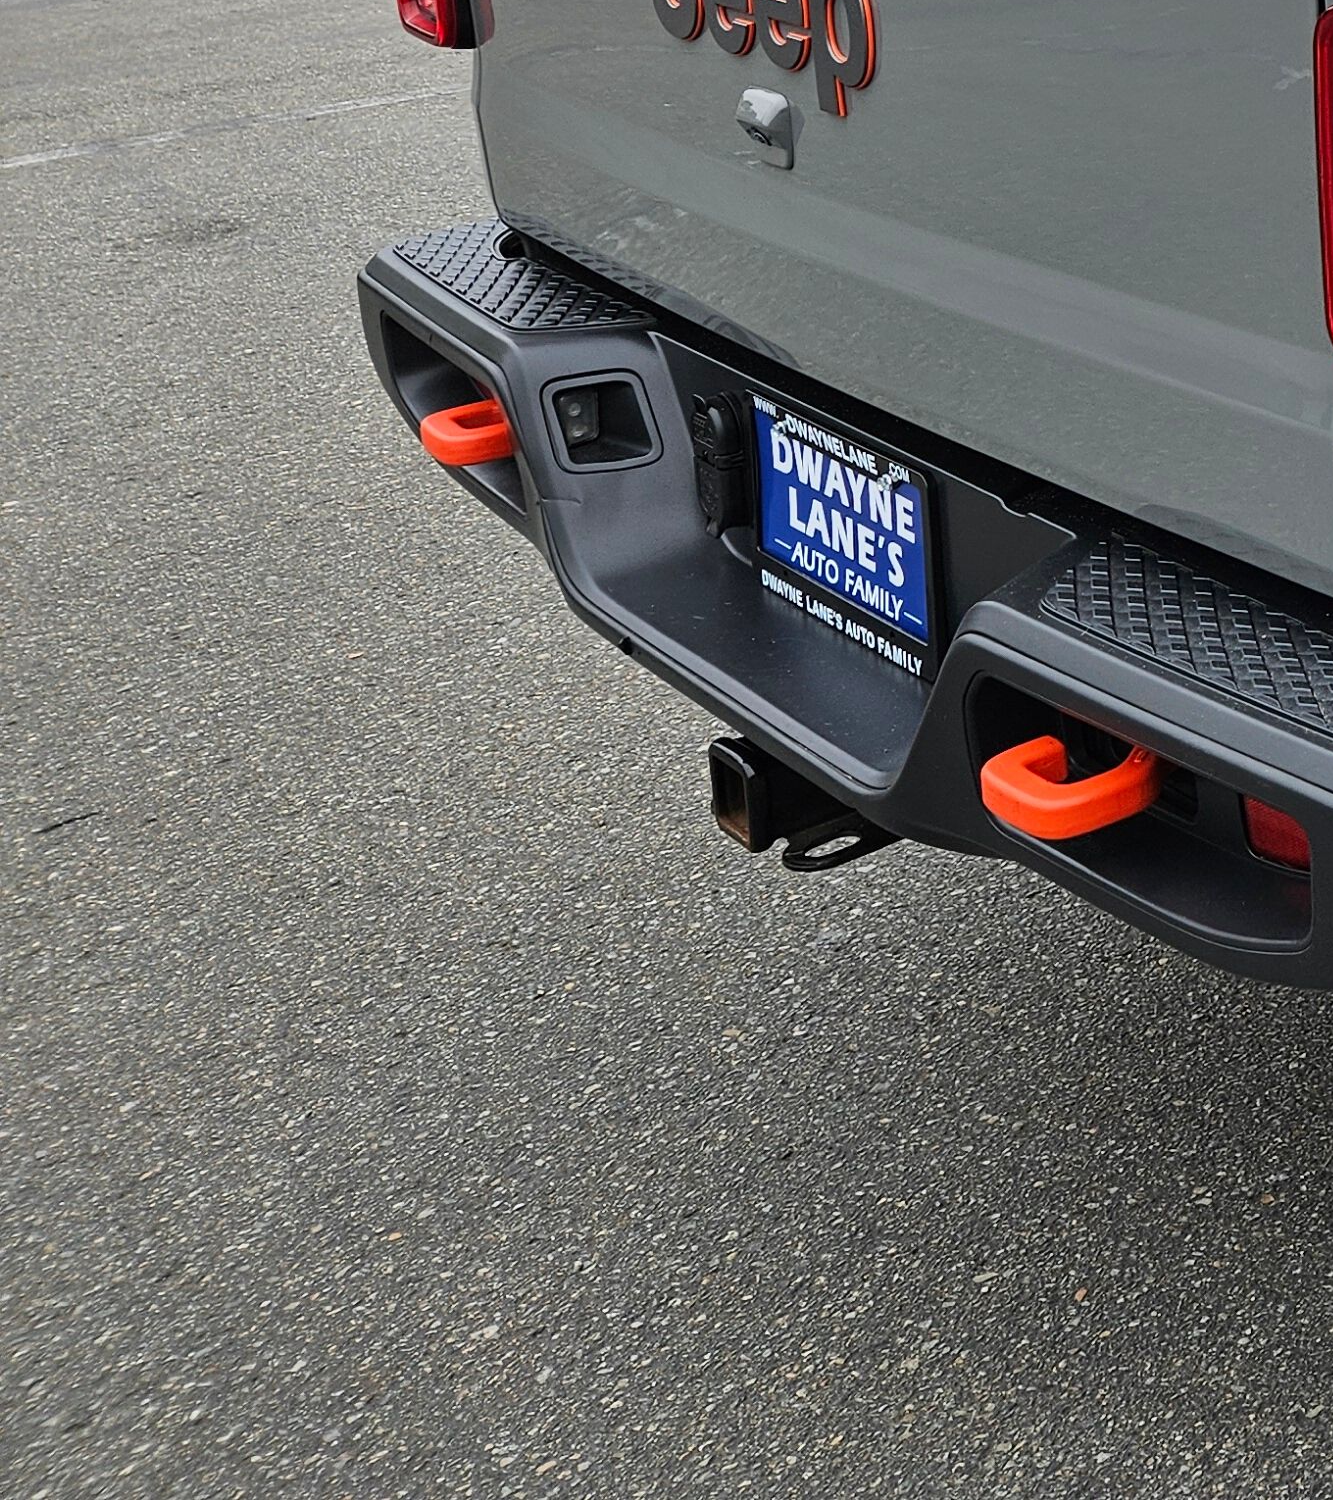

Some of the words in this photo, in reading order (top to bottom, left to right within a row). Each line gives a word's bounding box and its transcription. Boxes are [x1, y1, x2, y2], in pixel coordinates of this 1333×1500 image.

[770, 424, 916, 544] DWAYNE
[784, 413, 879, 476] DWAYNELANE
[788, 485, 905, 588] LANE'S
[790, 541, 839, 585] AUTO
[845, 568, 904, 622] FAMILY
[761, 568, 804, 608] DWAYNE
[805, 594, 843, 631] LANE'S
[845, 618, 875, 649] AUTO
[877, 635, 923, 677] FAMILY
